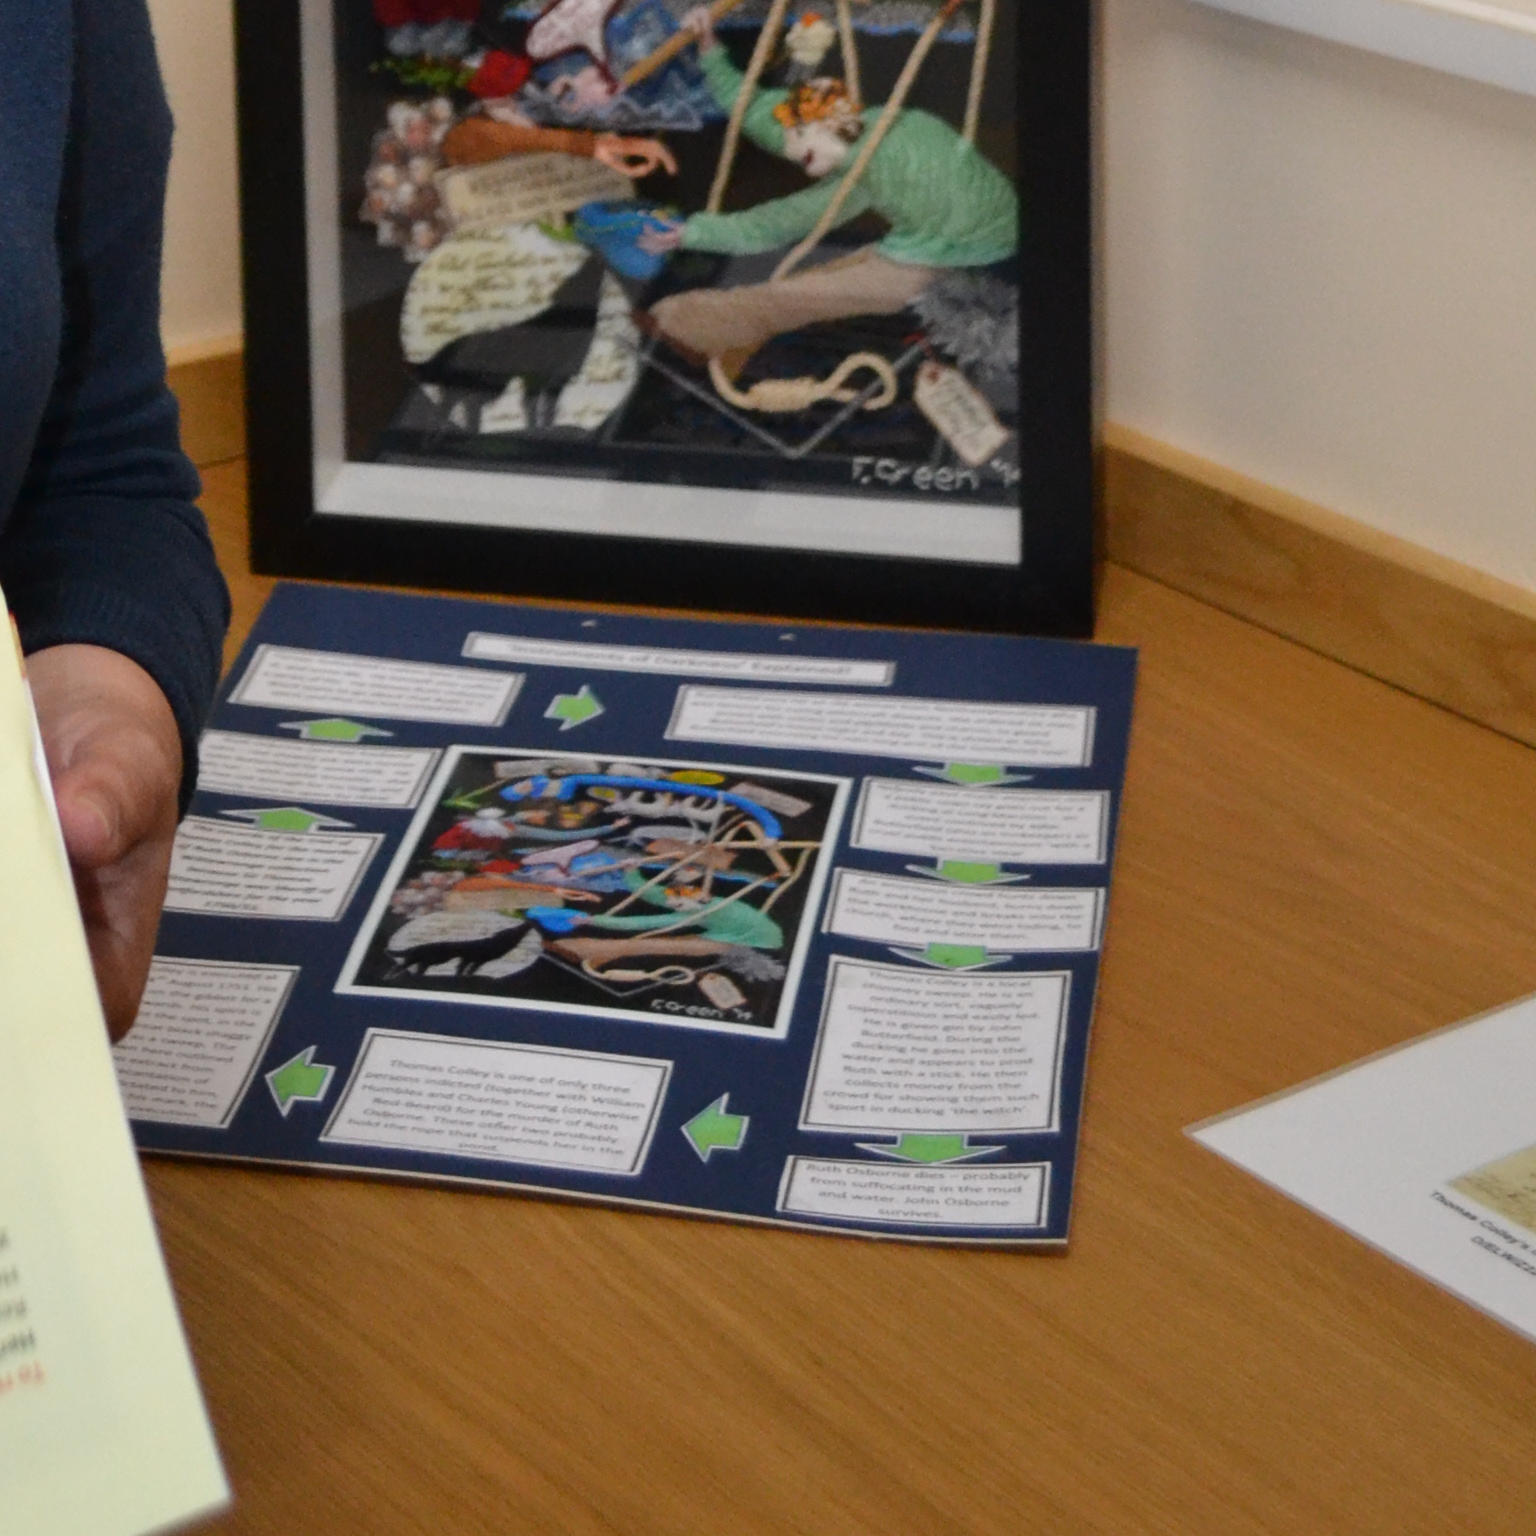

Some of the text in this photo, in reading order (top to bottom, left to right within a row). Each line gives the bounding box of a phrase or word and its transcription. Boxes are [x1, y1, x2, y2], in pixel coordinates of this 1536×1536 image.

[810, 1176, 847, 1186] from
[851, 1179, 935, 1192] suffocating
[850, 1193, 895, 1202] water.
[903, 1195, 940, 1205] John
[944, 1196, 1010, 1207] Osborne
